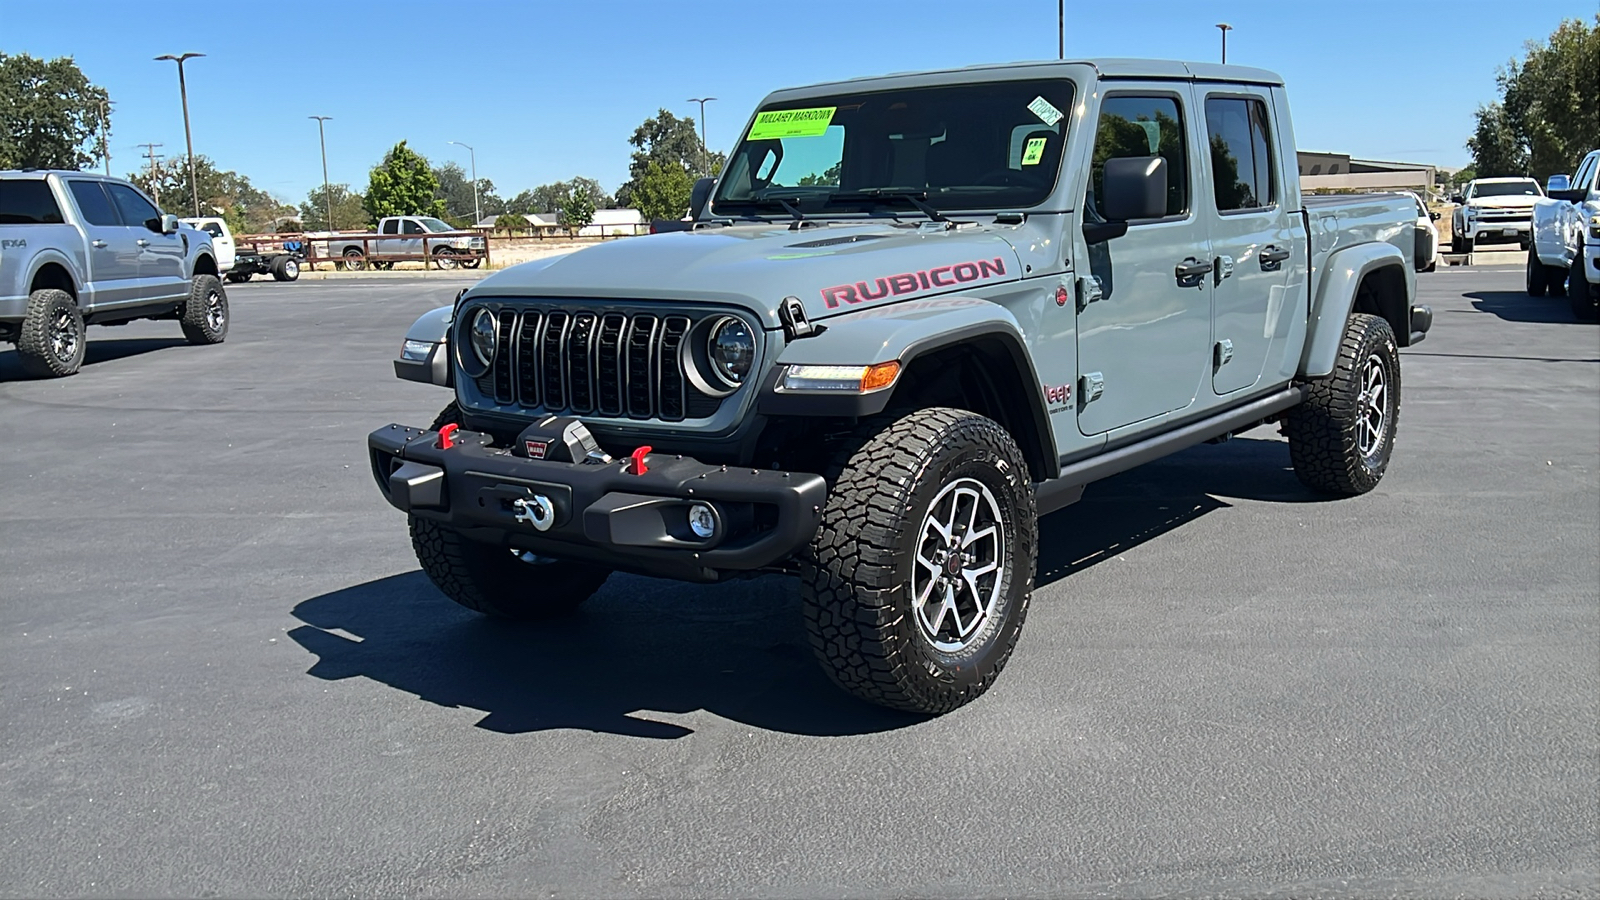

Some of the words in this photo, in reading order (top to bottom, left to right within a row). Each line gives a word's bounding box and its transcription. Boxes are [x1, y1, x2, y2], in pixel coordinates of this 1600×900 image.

[791, 109, 834, 121] MARKDOWN
[1, 238, 27, 250] FX4
[821, 257, 1006, 310] RUBICON
[529, 446, 544, 454] WARN
